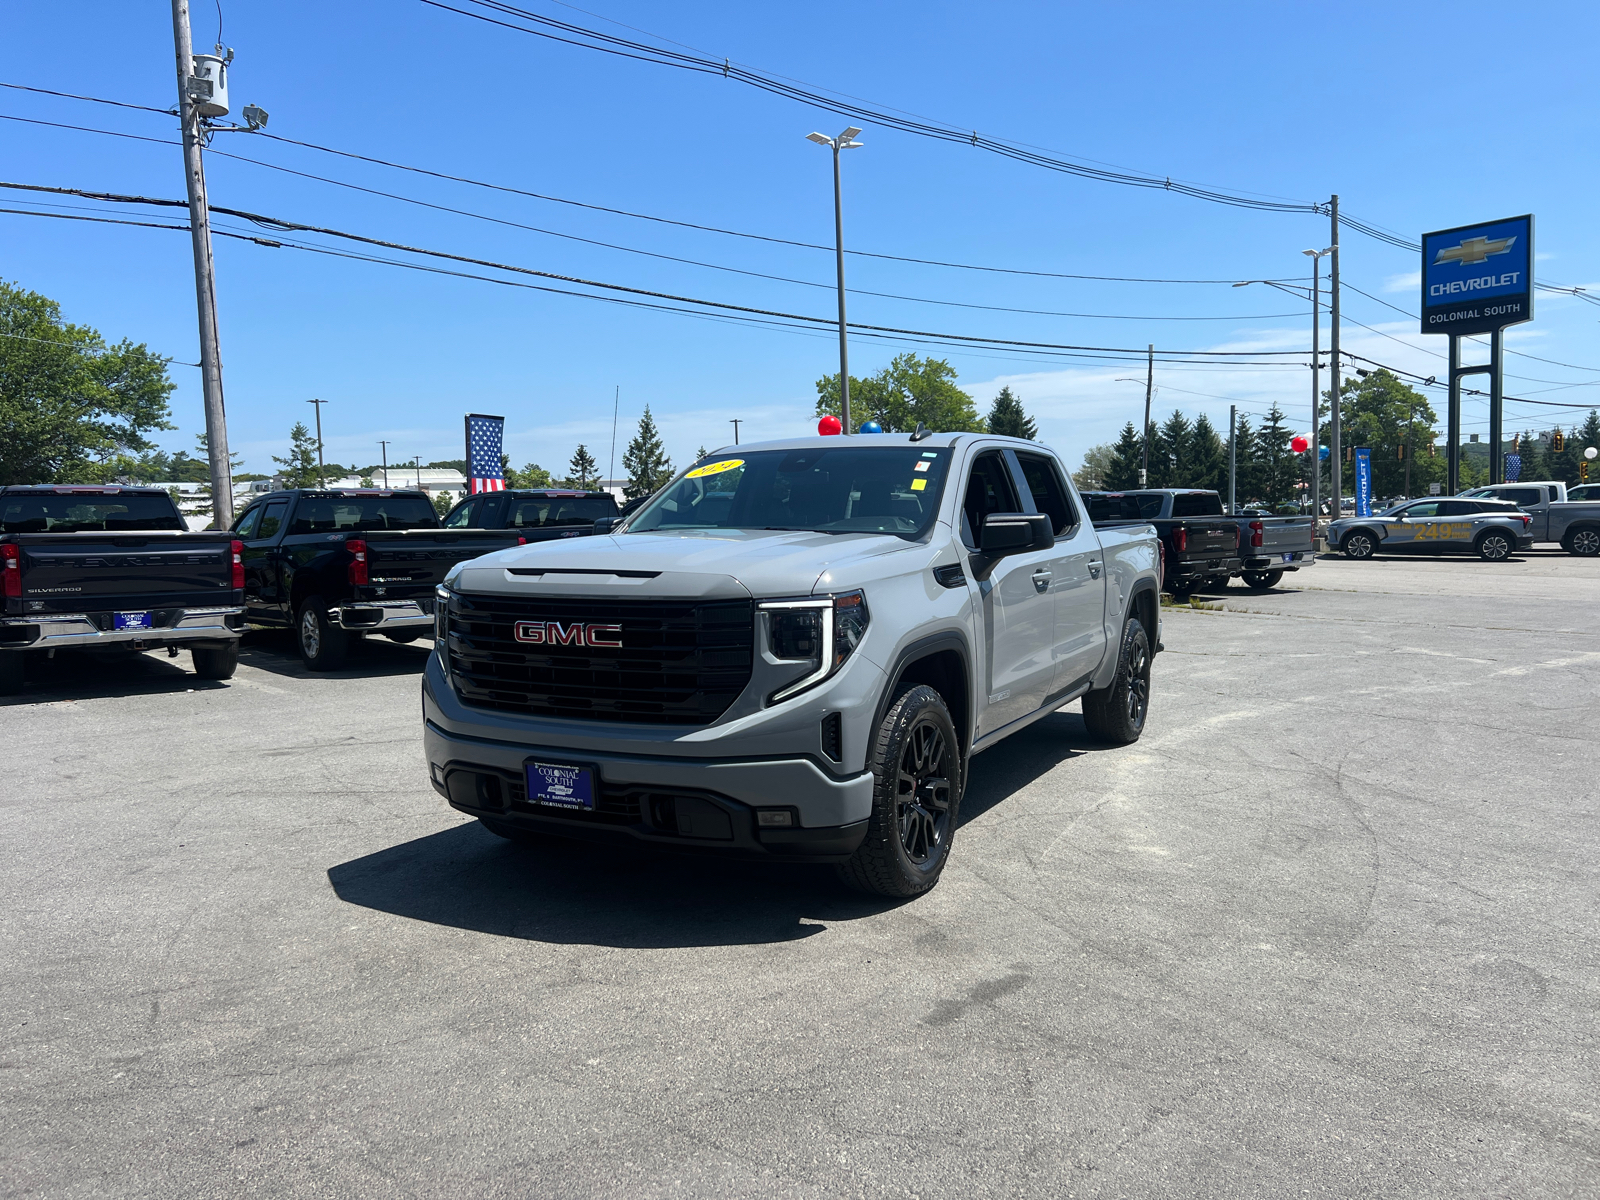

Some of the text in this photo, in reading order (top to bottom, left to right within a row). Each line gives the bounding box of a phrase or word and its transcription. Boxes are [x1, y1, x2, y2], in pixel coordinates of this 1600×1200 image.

[1430, 271, 1520, 296] CHEVROLET
[1429, 303, 1520, 324] COLONIAL SOUTH
[27, 586, 82, 594] SILVERADO
[514, 620, 623, 648] GMC
[538, 767, 579, 780] COLONIAL
[545, 775, 574, 787] SOUTH
[541, 800, 563, 808] COLONIAL
